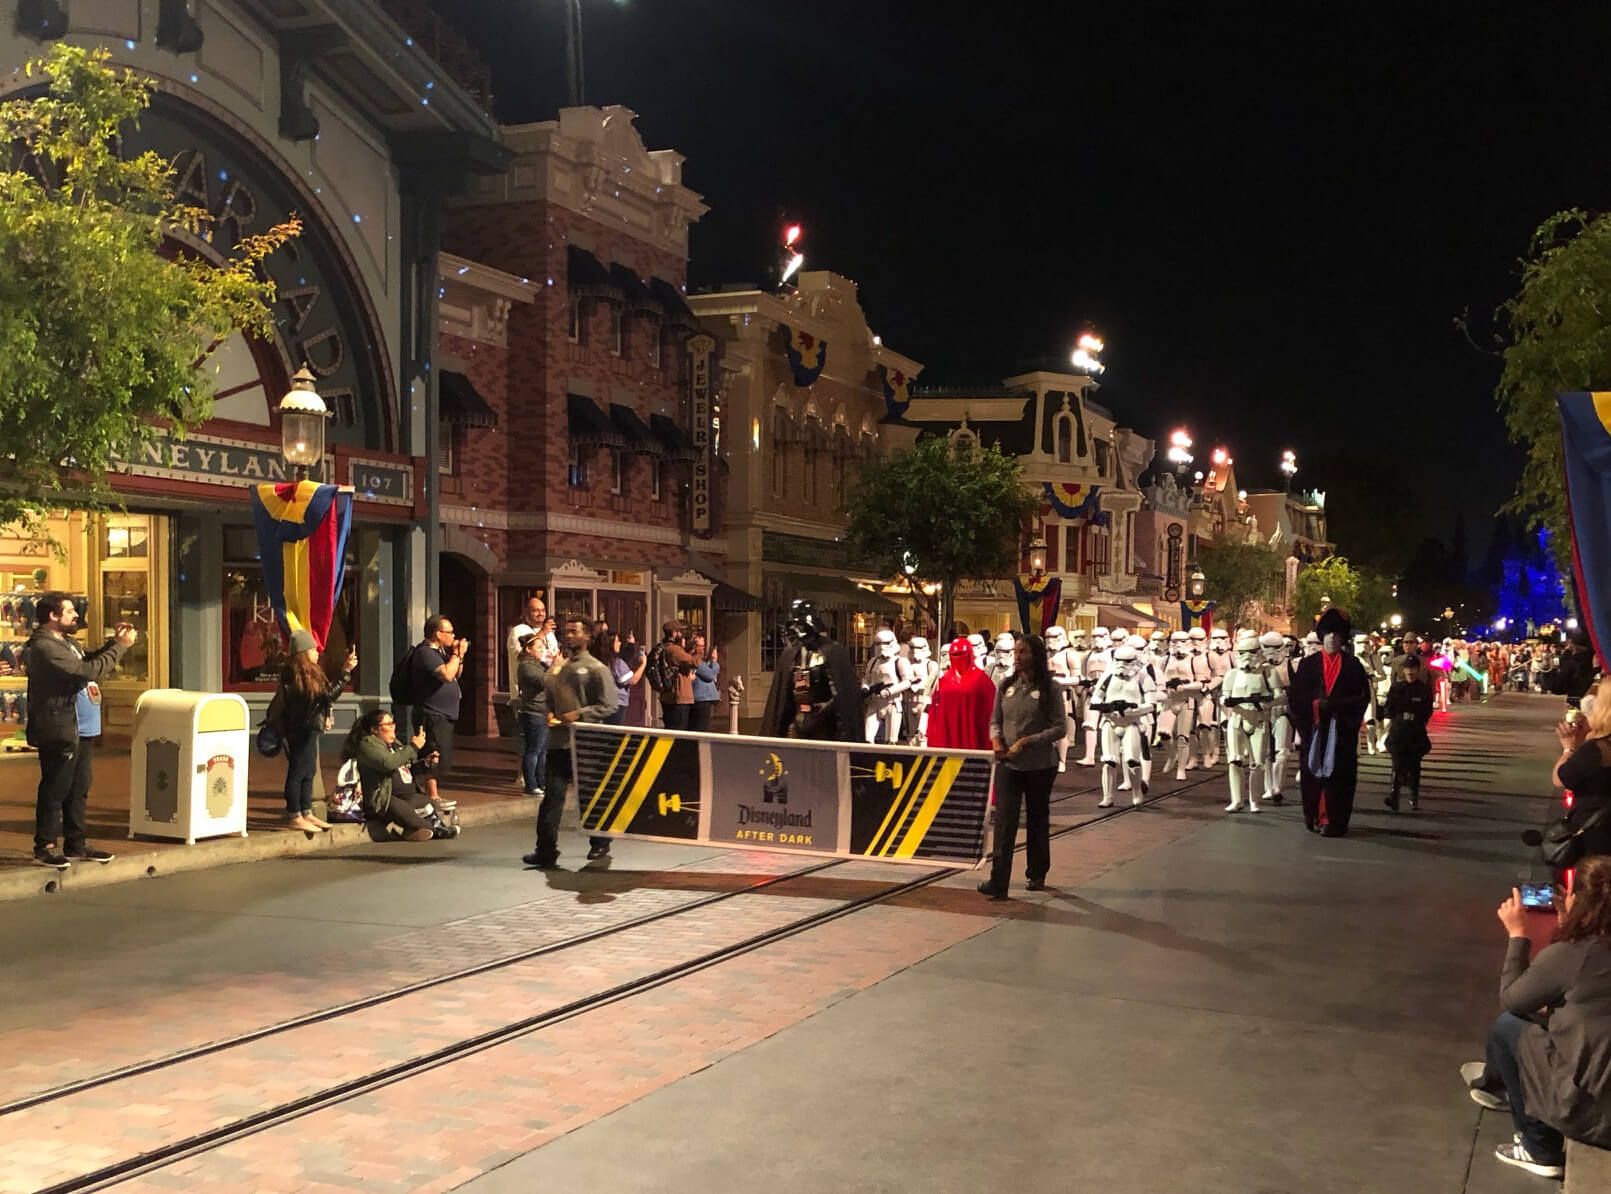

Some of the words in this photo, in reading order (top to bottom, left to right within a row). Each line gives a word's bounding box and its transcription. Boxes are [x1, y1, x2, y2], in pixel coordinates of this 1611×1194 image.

[695, 359, 708, 462] JEWELRY
[362, 473, 393, 490] 107
[695, 465, 708, 519] SHOP
[737, 803, 812, 829] Disneyland
[736, 829, 774, 842] AFTER
[779, 833, 812, 845] DARK
